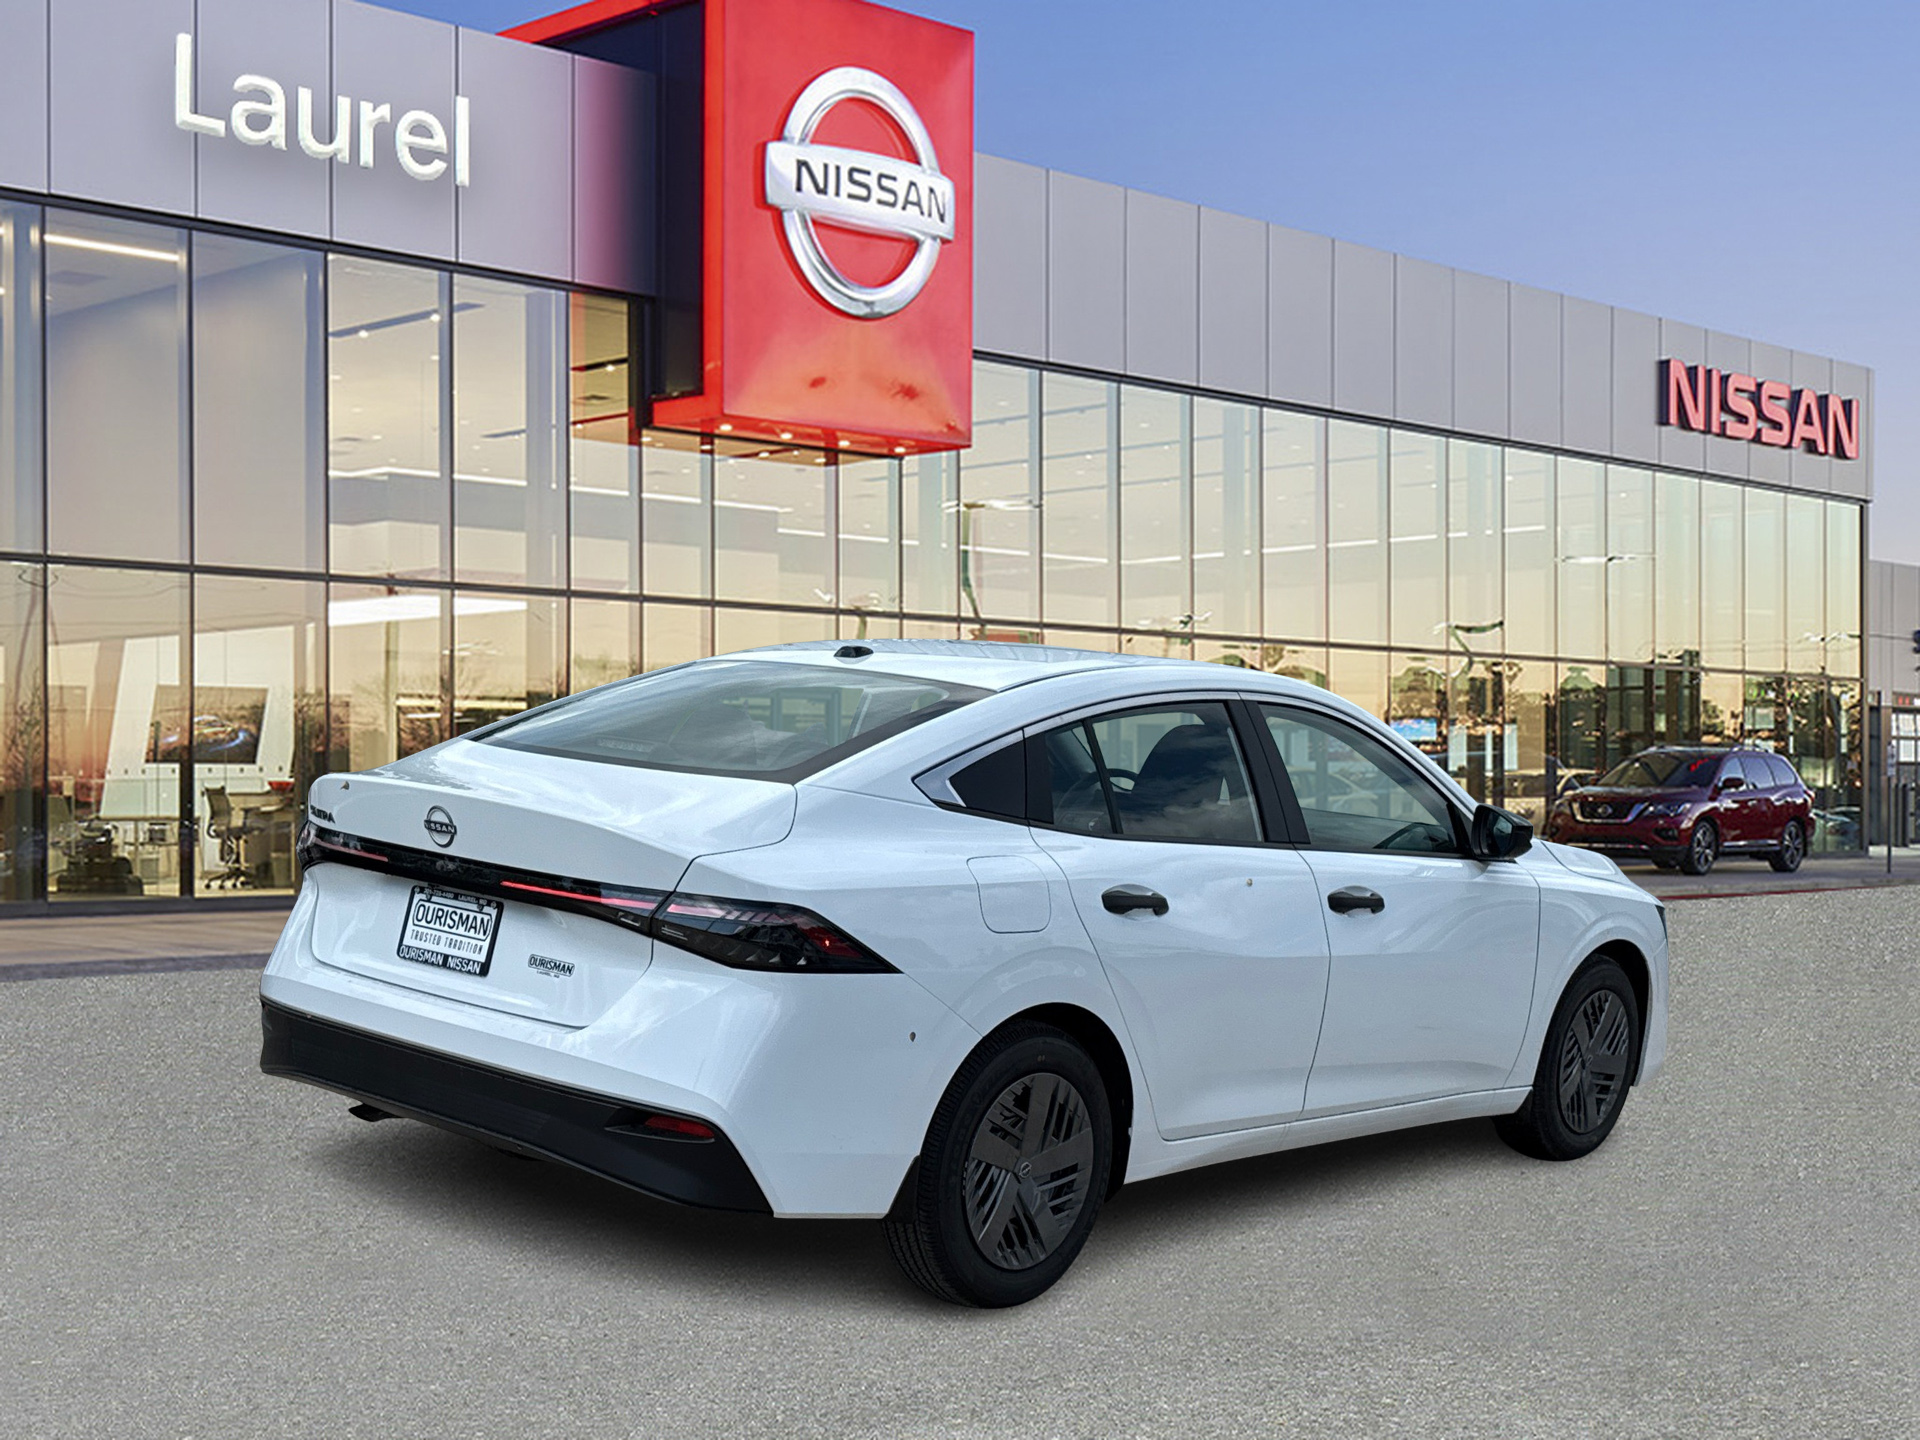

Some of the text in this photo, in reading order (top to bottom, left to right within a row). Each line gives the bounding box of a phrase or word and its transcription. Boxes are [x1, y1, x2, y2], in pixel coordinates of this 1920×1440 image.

[175, 32, 470, 187] Laurel
[795, 158, 946, 223] NISSAN
[1656, 357, 1860, 460] NISSAN
[415, 904, 490, 937] OURISMAN
[410, 929, 483, 955] TRUSTED TRADITION
[399, 945, 481, 974] OURISMAN NISSAN
[530, 956, 574, 975] OURISMAN
